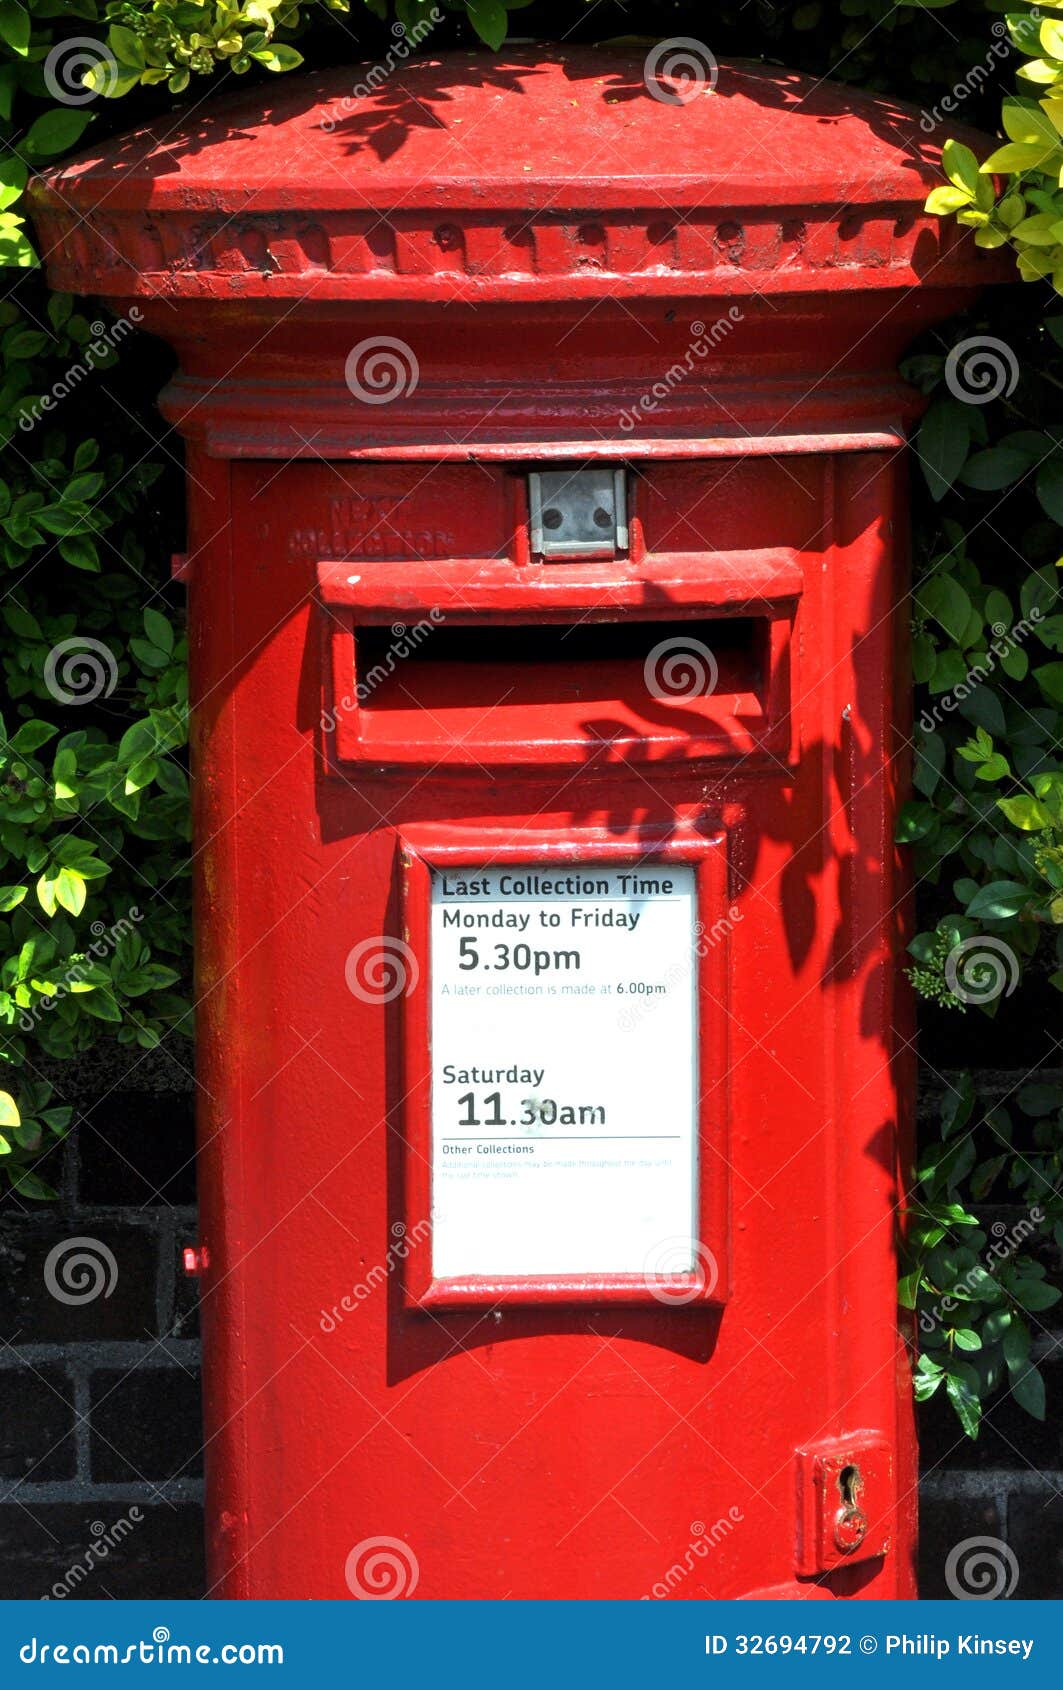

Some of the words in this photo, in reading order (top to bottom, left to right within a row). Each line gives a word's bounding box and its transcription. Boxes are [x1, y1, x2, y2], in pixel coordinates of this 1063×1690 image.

[442, 877, 490, 895] Last
[499, 876, 609, 895] Collection
[616, 875, 673, 894] Time
[443, 909, 530, 932] Monday
[540, 910, 561, 928] to
[571, 908, 641, 931] Friday
[458, 936, 581, 976] 5.30pm
[441, 984, 450, 995] A
[454, 984, 481, 996] later
[486, 984, 543, 995] collection
[548, 984, 557, 995] is
[562, 983, 596, 995] made
[600, 983, 612, 995] at
[616, 982, 666, 996] 6.00pm
[443, 1064, 545, 1088] Saturday
[457, 1091, 606, 1126] 11.30am
[442, 1144, 473, 1155] Other
[476, 1144, 534, 1155] Collections
